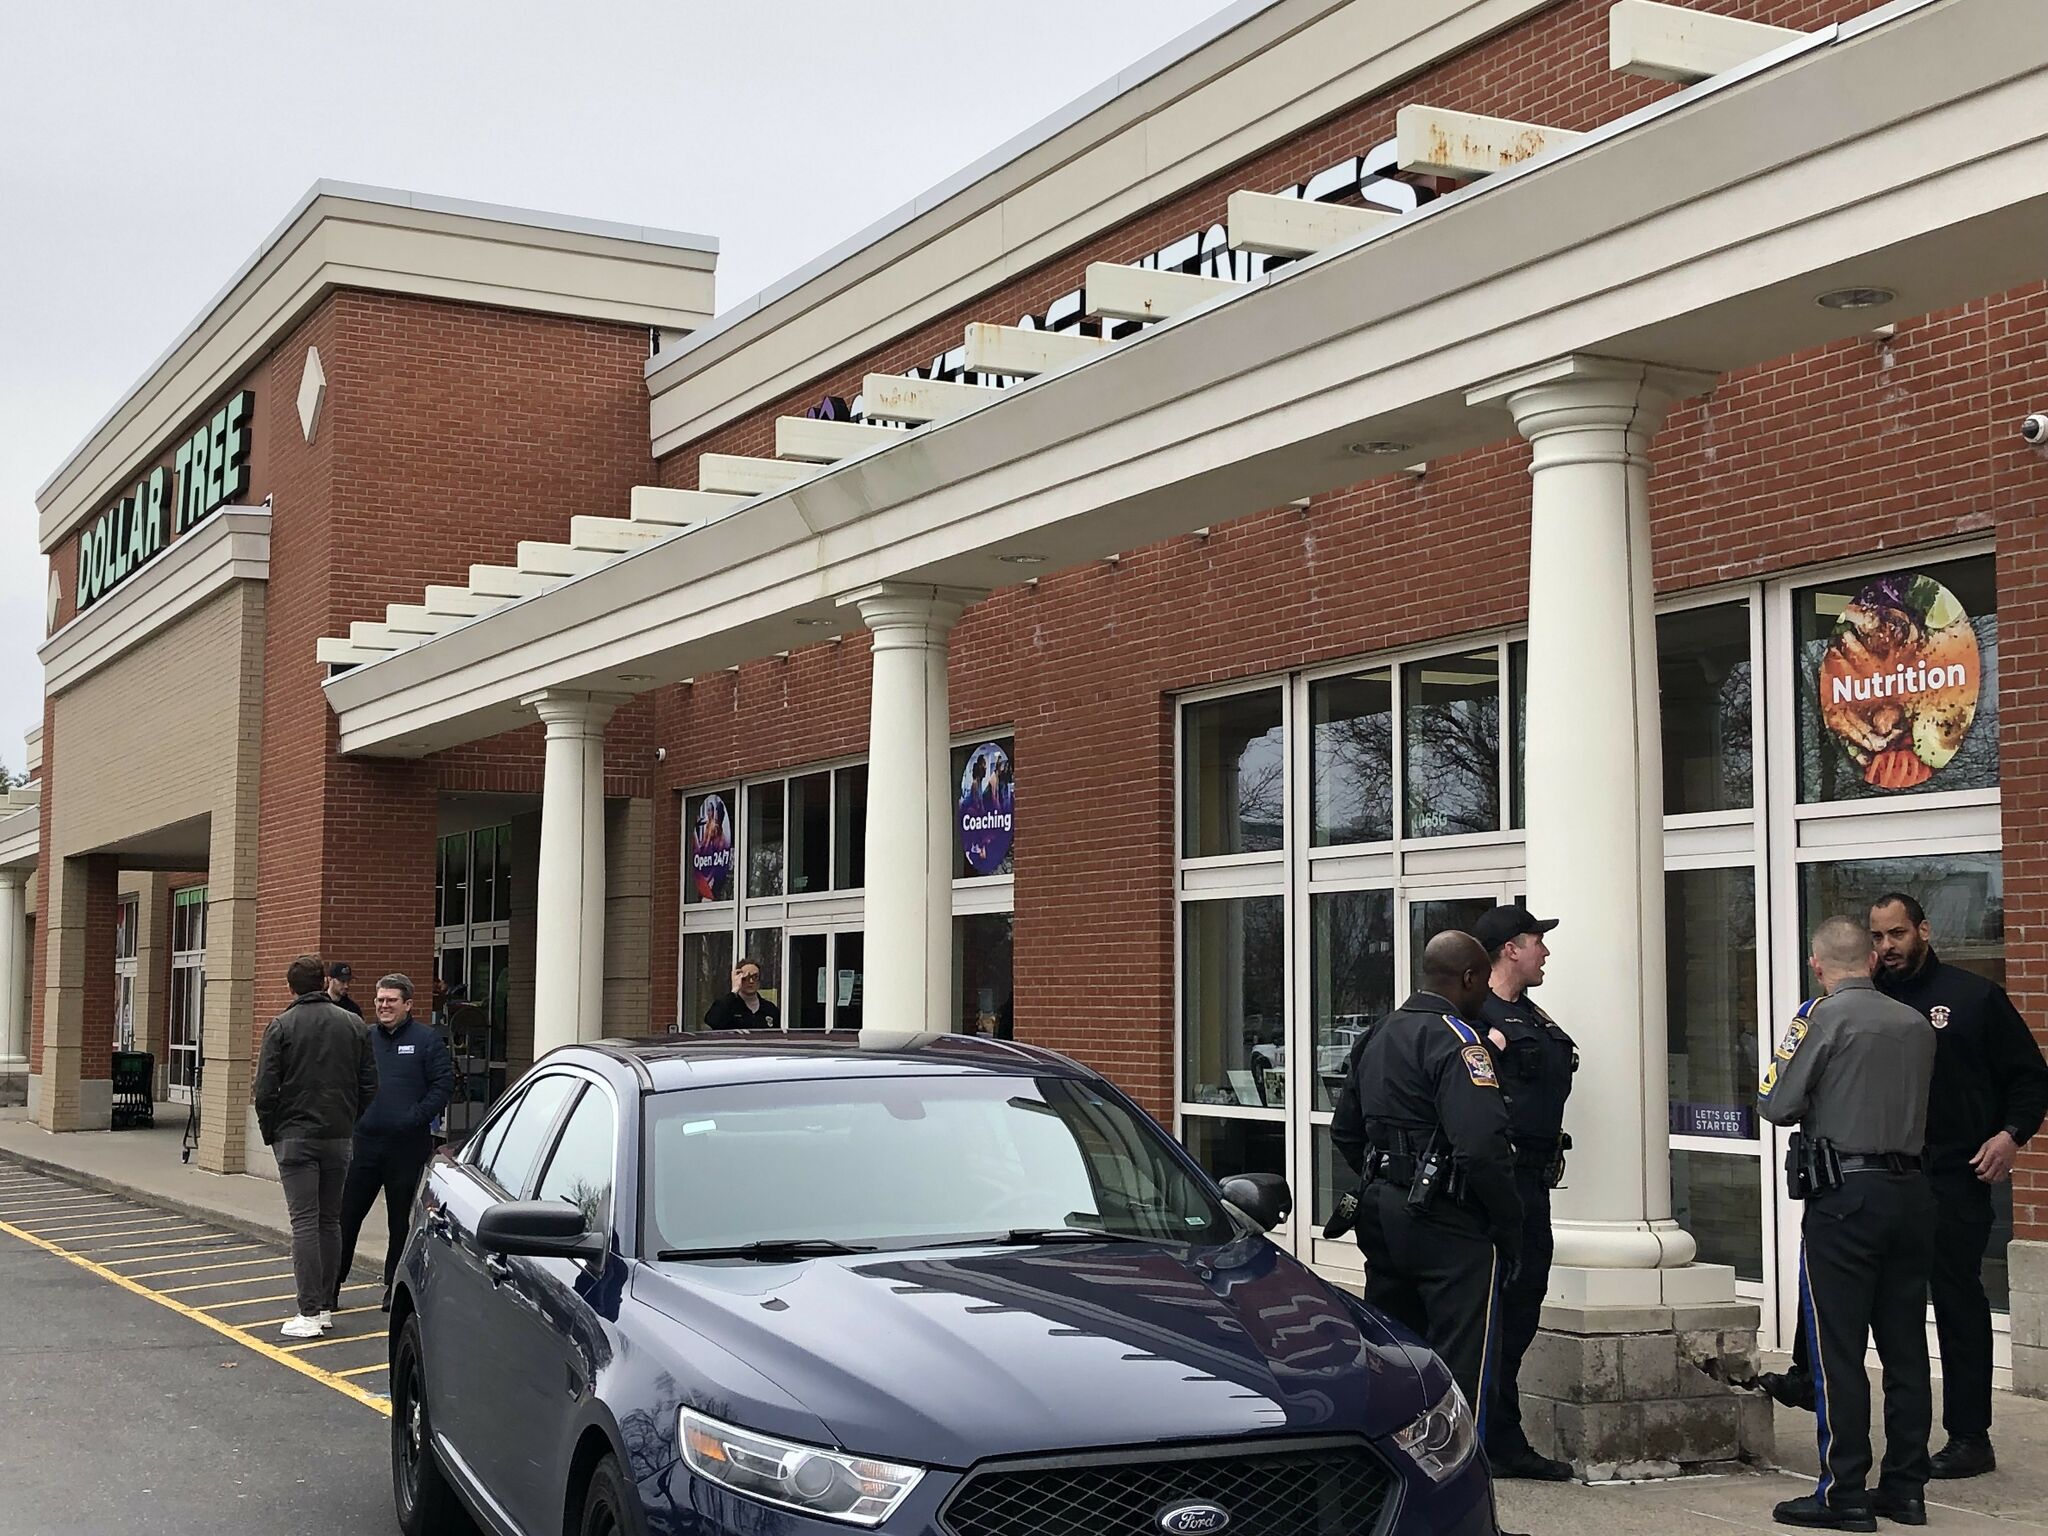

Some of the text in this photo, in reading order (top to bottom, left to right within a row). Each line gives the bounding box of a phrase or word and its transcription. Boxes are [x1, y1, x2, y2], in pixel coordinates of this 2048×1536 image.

[77, 390, 251, 610] DOLLAR TREE
[1832, 660, 1966, 704] Nutrition
[963, 810, 1012, 832] Coaching
[693, 849, 730, 871] Open 24/7
[1695, 1109, 1742, 1121] LET'S GET
[1696, 1120, 1740, 1132] STARTED
[1178, 1510, 1216, 1530] Ford
